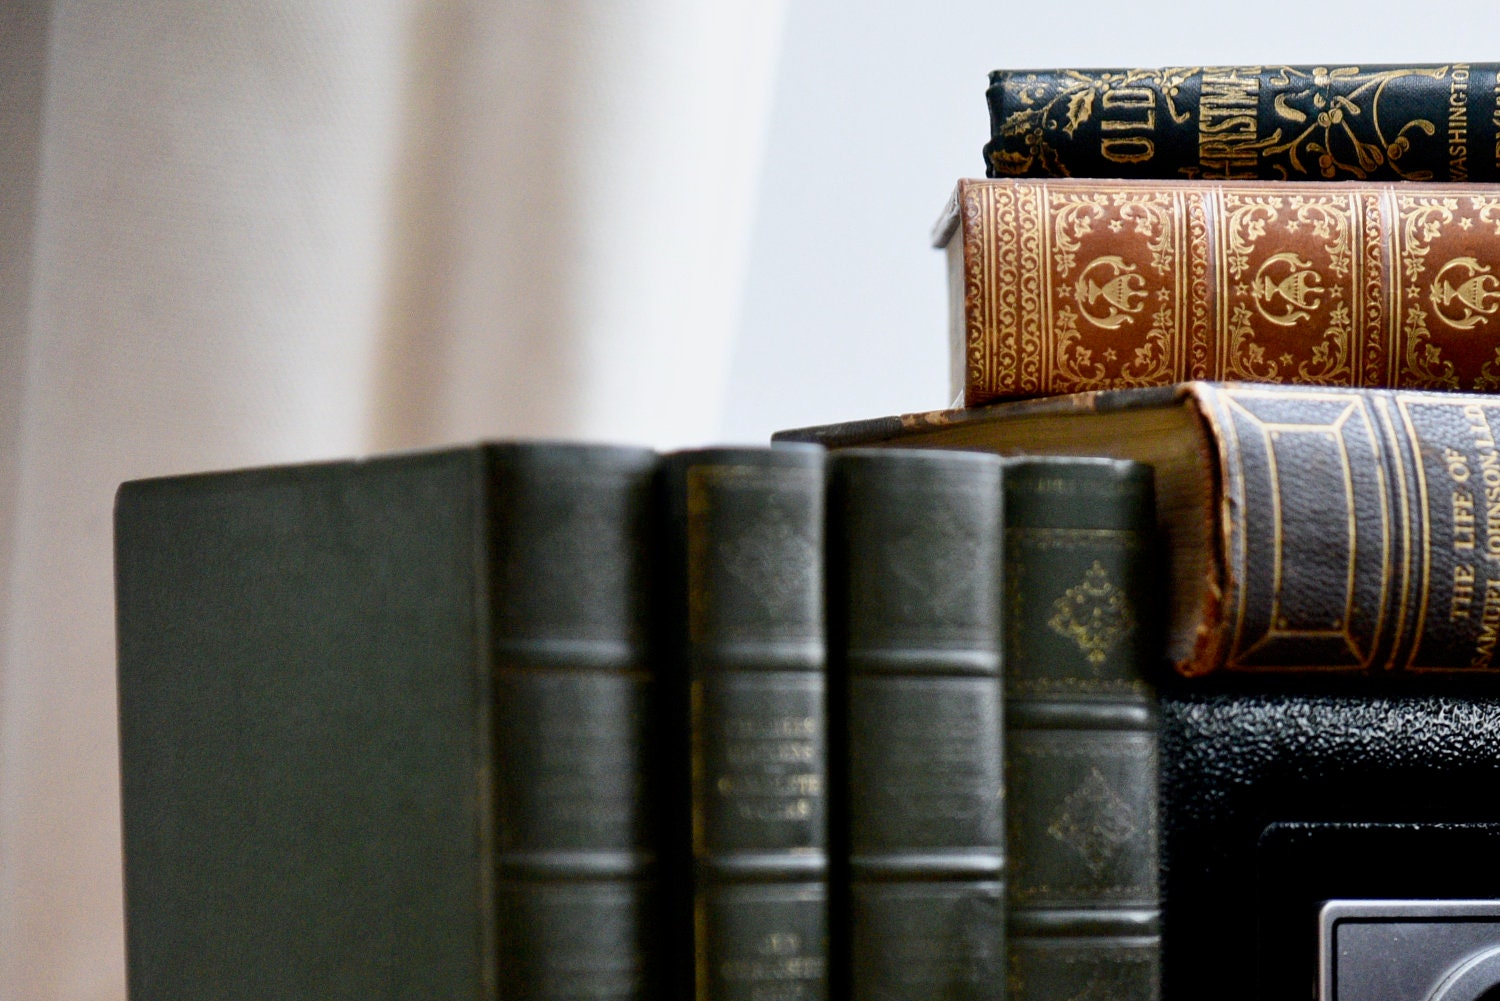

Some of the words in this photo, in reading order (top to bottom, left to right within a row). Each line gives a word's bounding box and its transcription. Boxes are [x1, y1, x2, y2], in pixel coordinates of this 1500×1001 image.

[1101, 88, 1155, 164] OLD
[1445, 448, 1471, 484] OF
[1452, 491, 1476, 550] LIFE
[1451, 564, 1475, 620] THE
